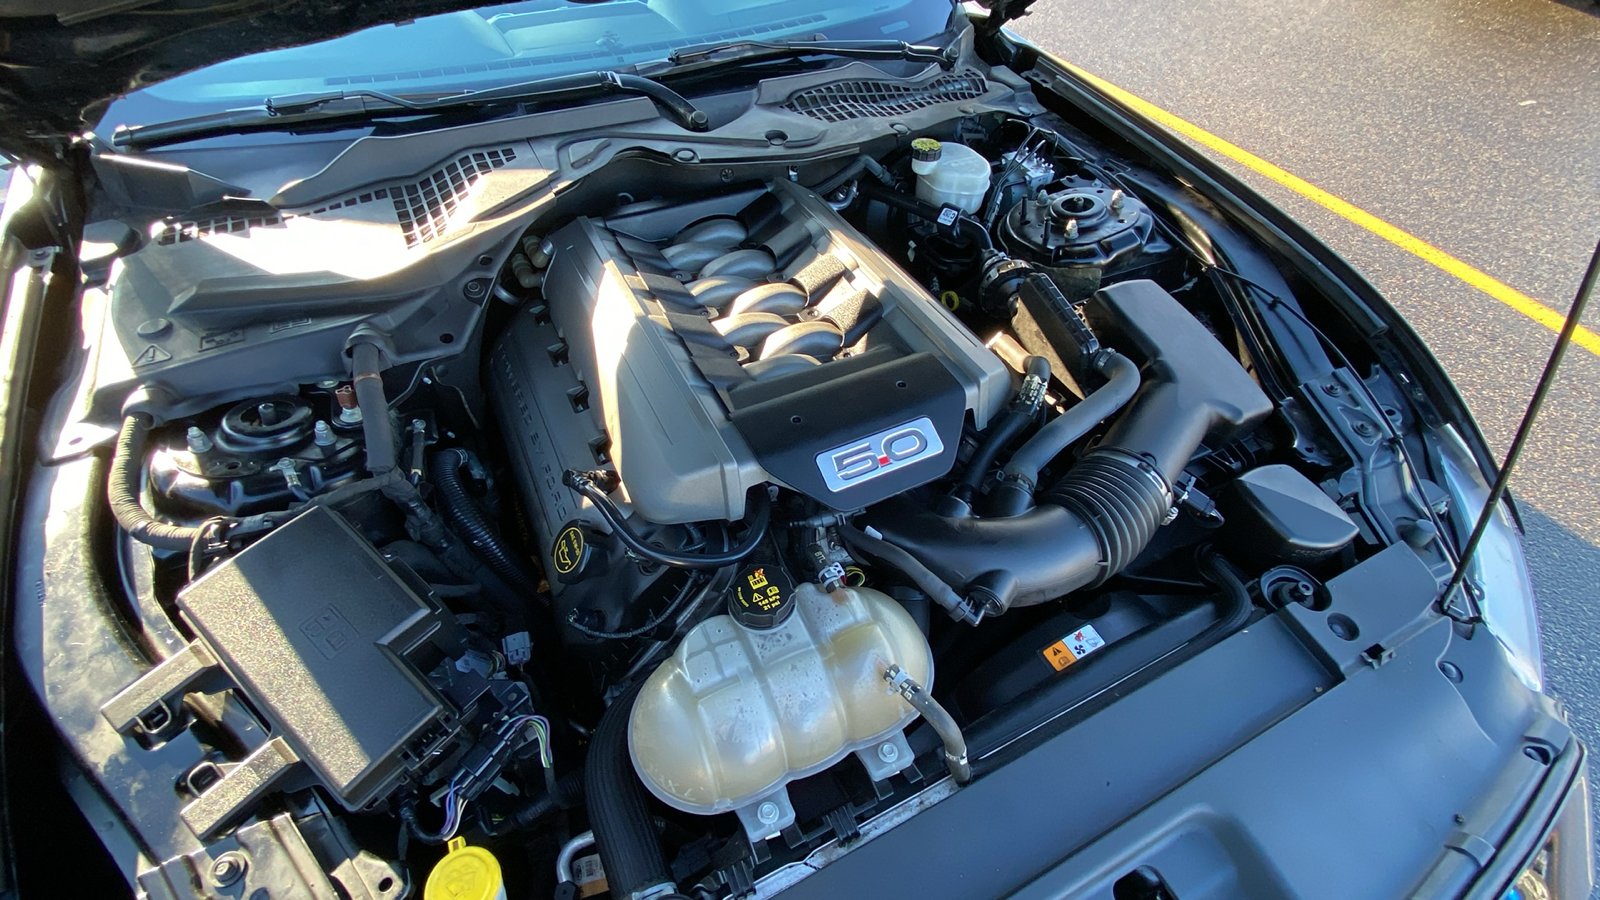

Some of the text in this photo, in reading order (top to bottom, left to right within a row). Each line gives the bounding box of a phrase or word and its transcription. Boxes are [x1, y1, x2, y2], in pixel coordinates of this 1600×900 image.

[529, 430, 545, 453] BY
[541, 460, 567, 522] FORD
[831, 427, 928, 481] 5.0
